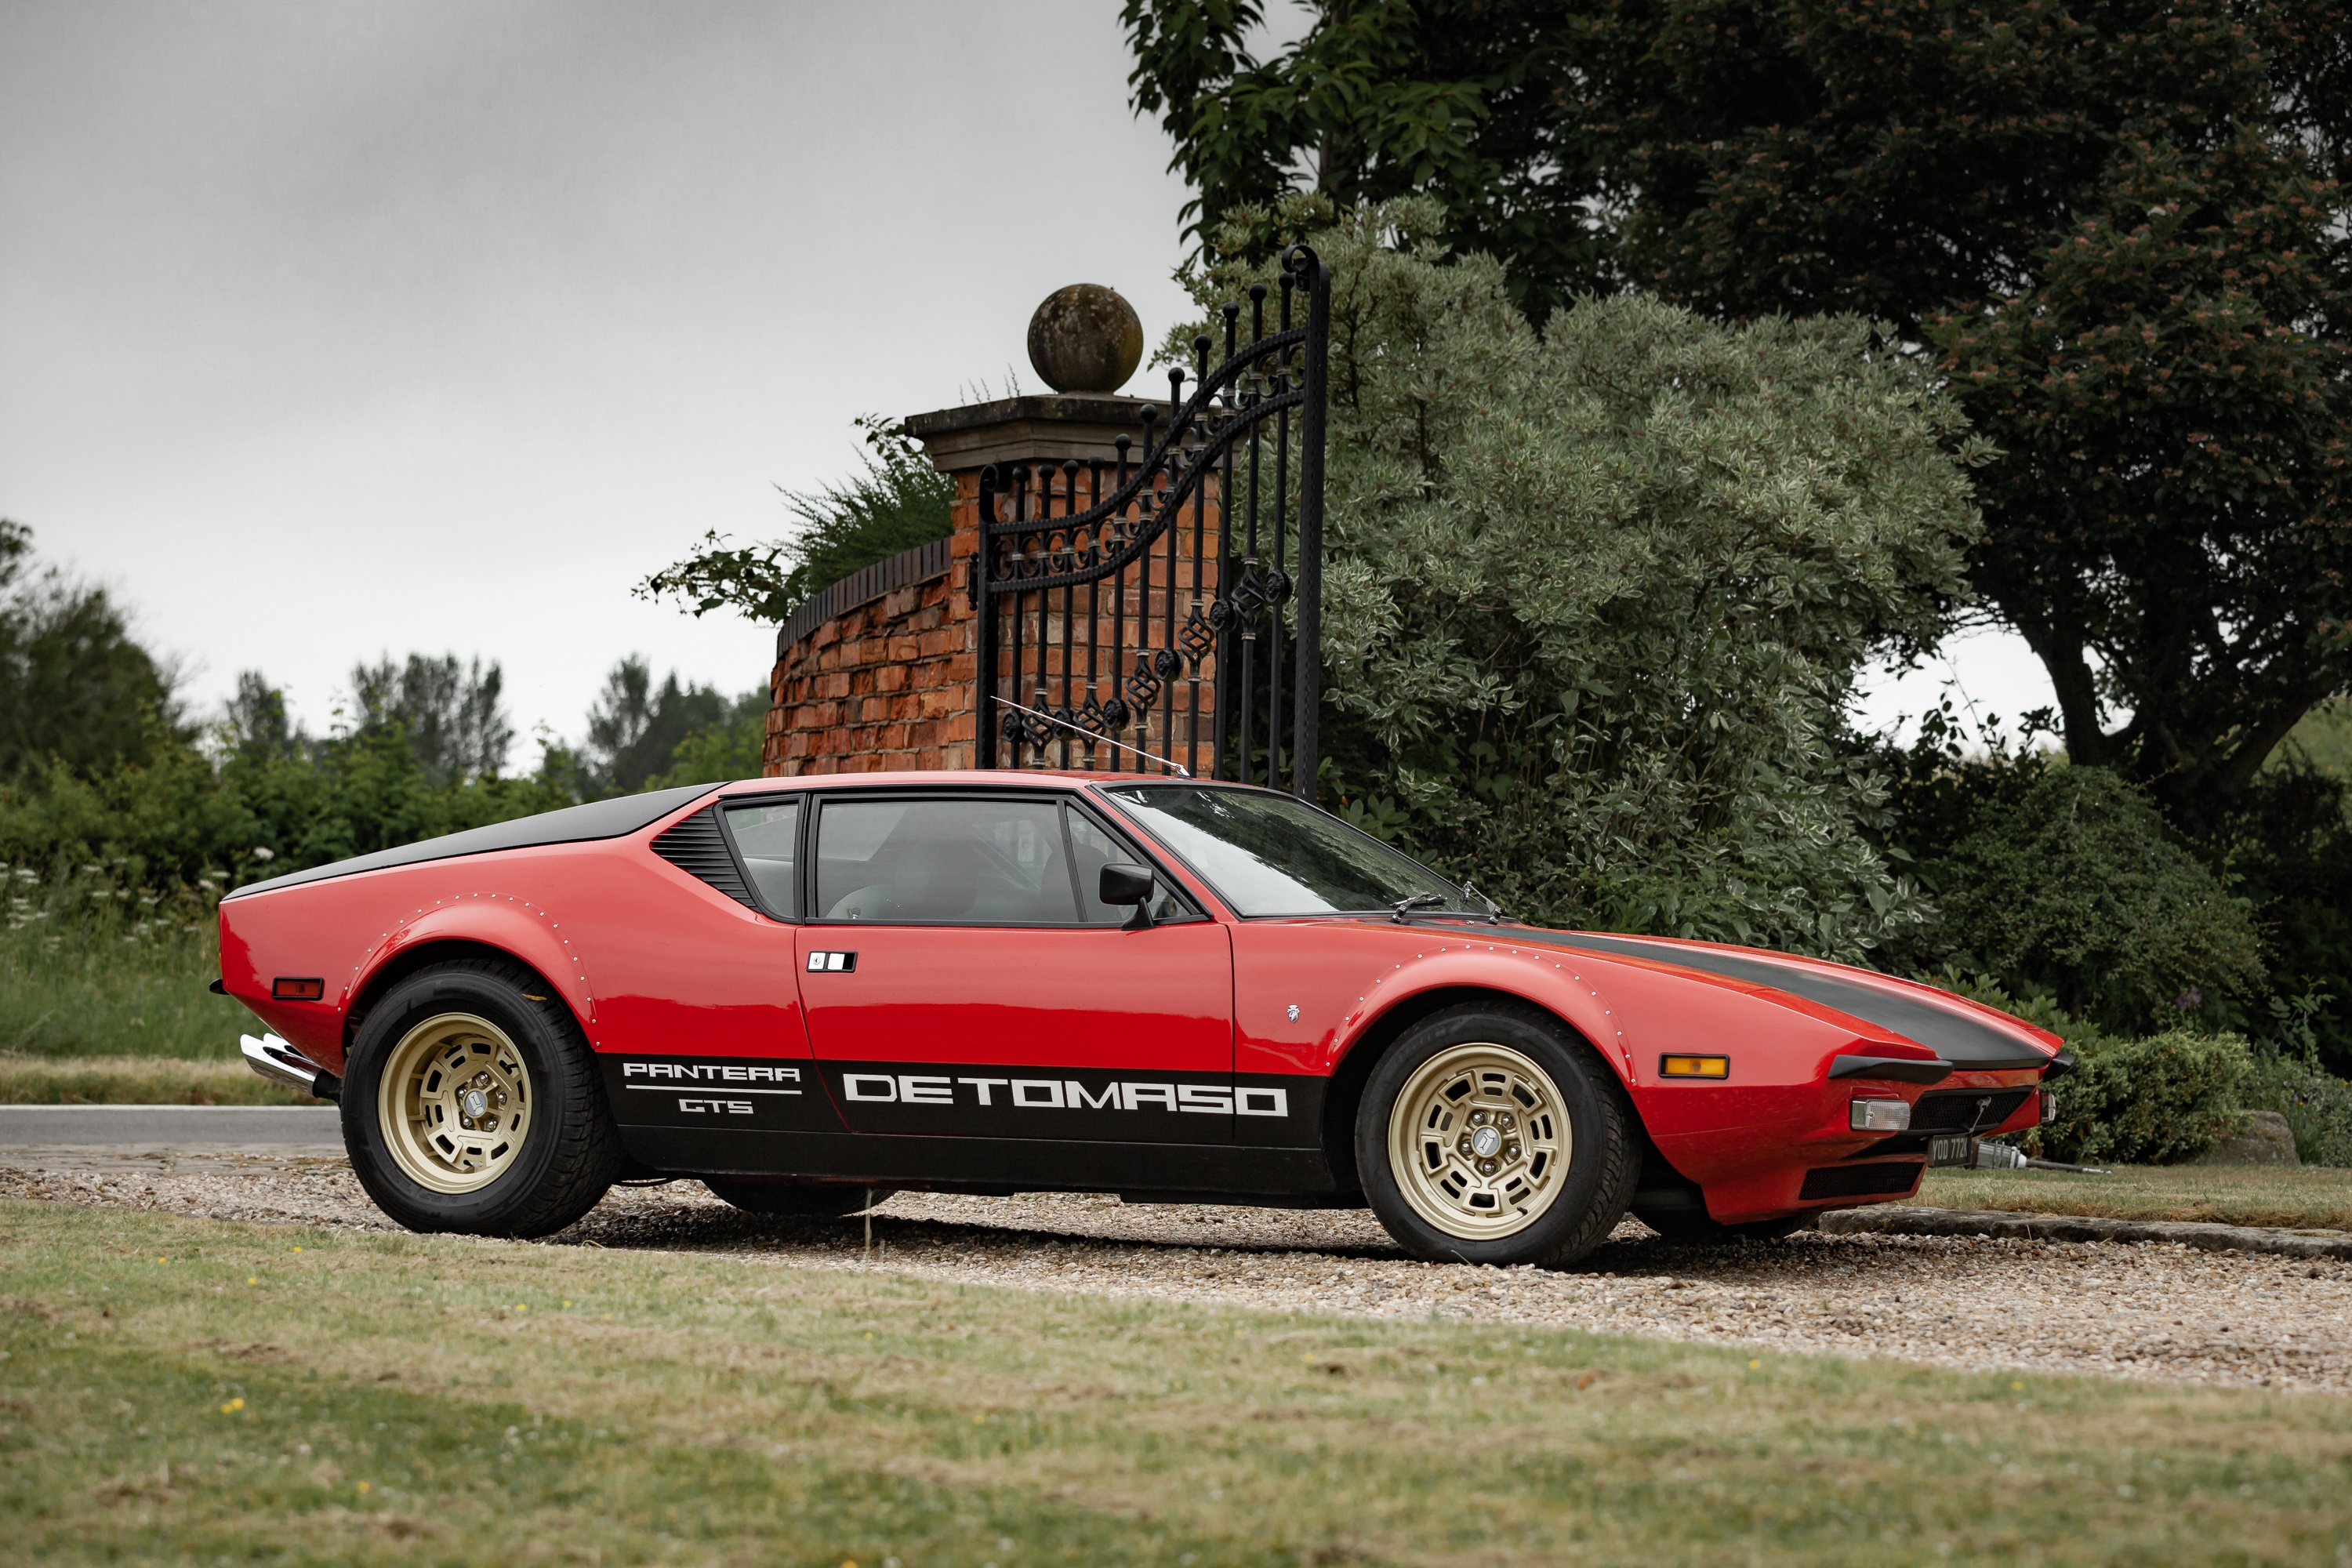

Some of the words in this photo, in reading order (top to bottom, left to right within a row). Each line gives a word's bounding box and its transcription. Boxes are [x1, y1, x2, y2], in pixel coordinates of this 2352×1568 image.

[623, 1062, 800, 1082] PANTERA
[679, 1098, 753, 1114] GTS
[1933, 1139, 1948, 1160] YOD
[1951, 1137, 1968, 1159] 772K
